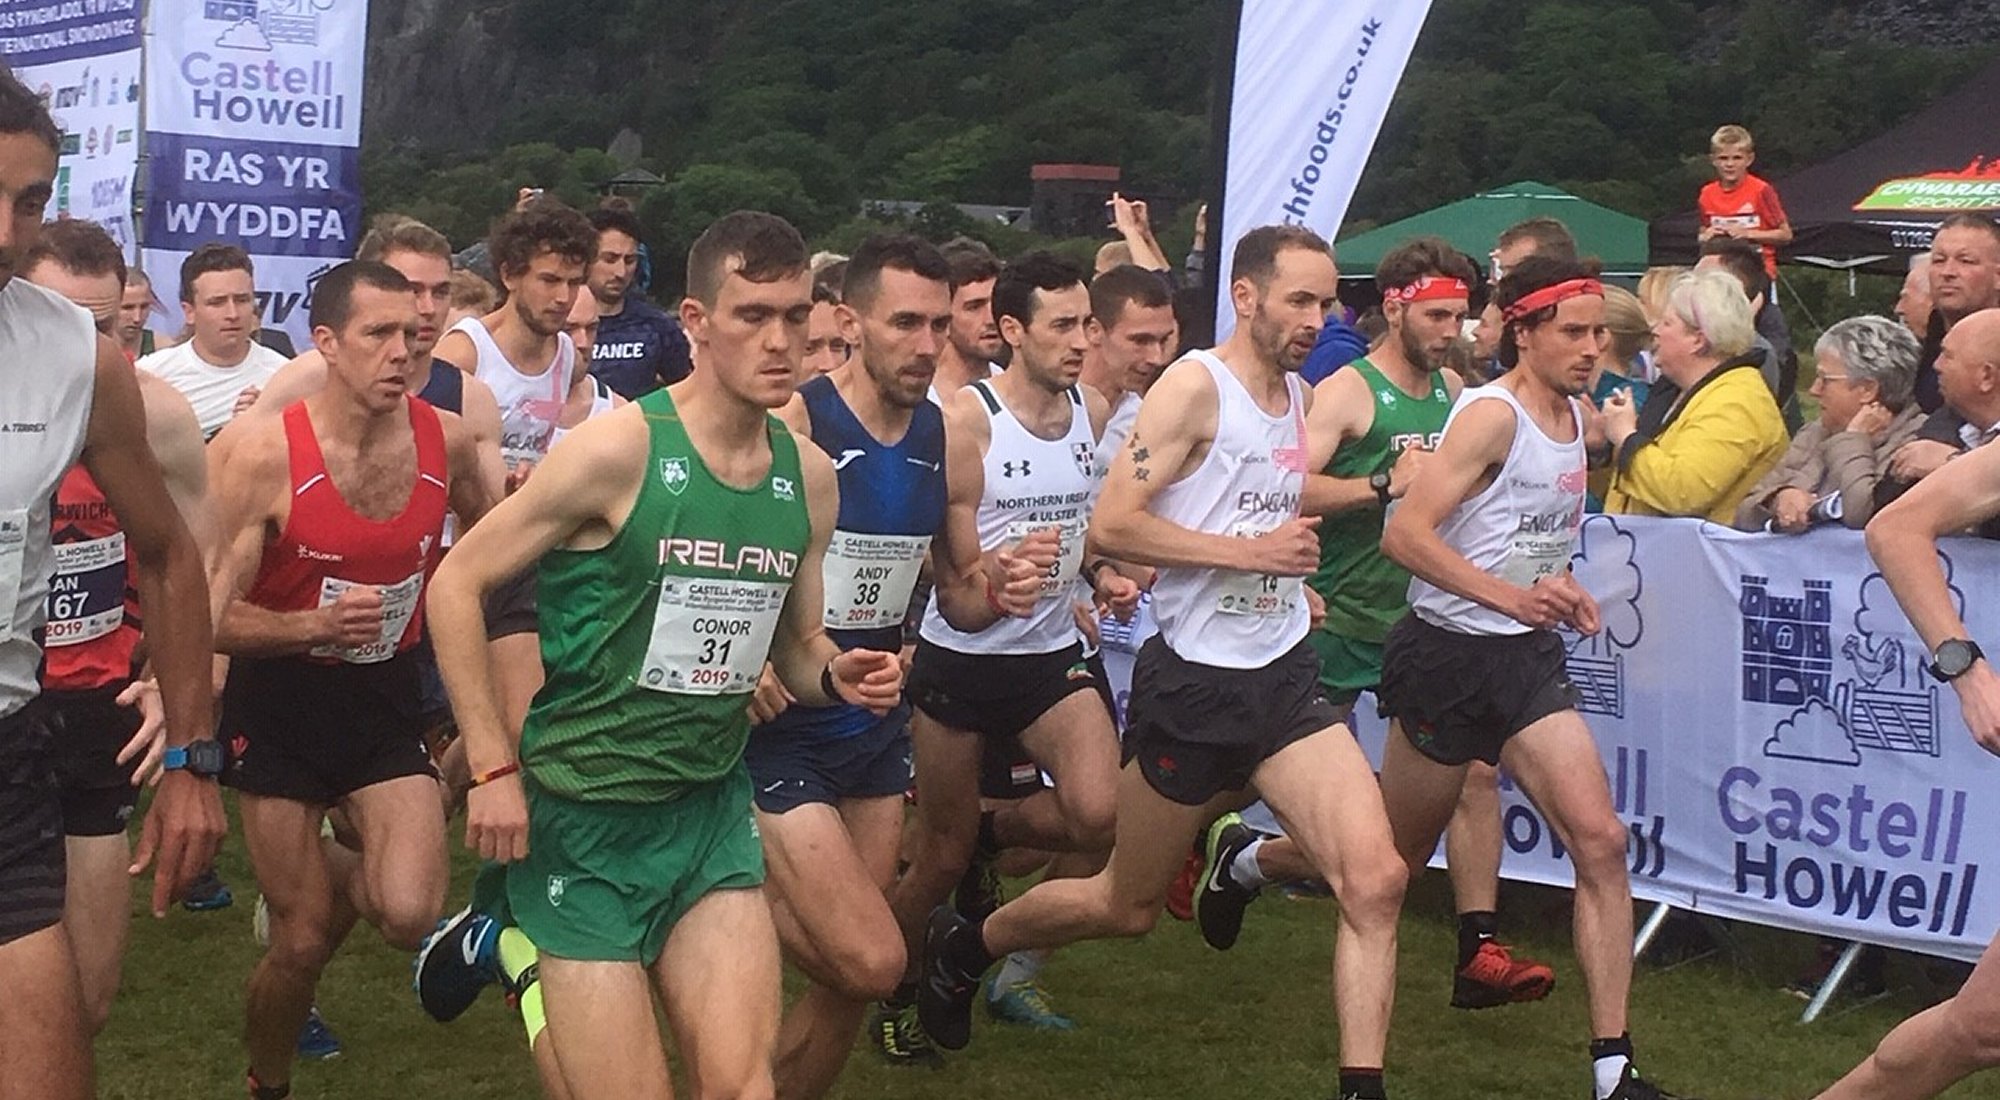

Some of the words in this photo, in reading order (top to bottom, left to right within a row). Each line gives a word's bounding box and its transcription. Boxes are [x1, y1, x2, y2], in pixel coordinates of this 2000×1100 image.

[180, 51, 332, 97] Castell
[193, 88, 344, 130] Howell
[184, 148, 265, 186] RAS
[277, 154, 331, 190] YR
[166, 200, 346, 241] WYDDFA
[591, 342, 644, 359] RANCE
[996, 494, 1063, 510] NORTHERN
[1040, 507, 1078, 522] ULSTER
[658, 538, 798, 578] IRELAND
[854, 566, 893, 580] ANDY
[689, 584, 730, 597] CASTELL
[1259, 574, 1278, 593] 14
[853, 583, 881, 606] 38
[846, 608, 877, 622] 2019
[45, 621, 83, 638] 2019
[692, 617, 752, 636] CONOR
[698, 638, 732, 666] 31
[691, 668, 730, 686] 2019
[1718, 765, 1967, 864] Castell
[1735, 841, 1978, 937] Howell
